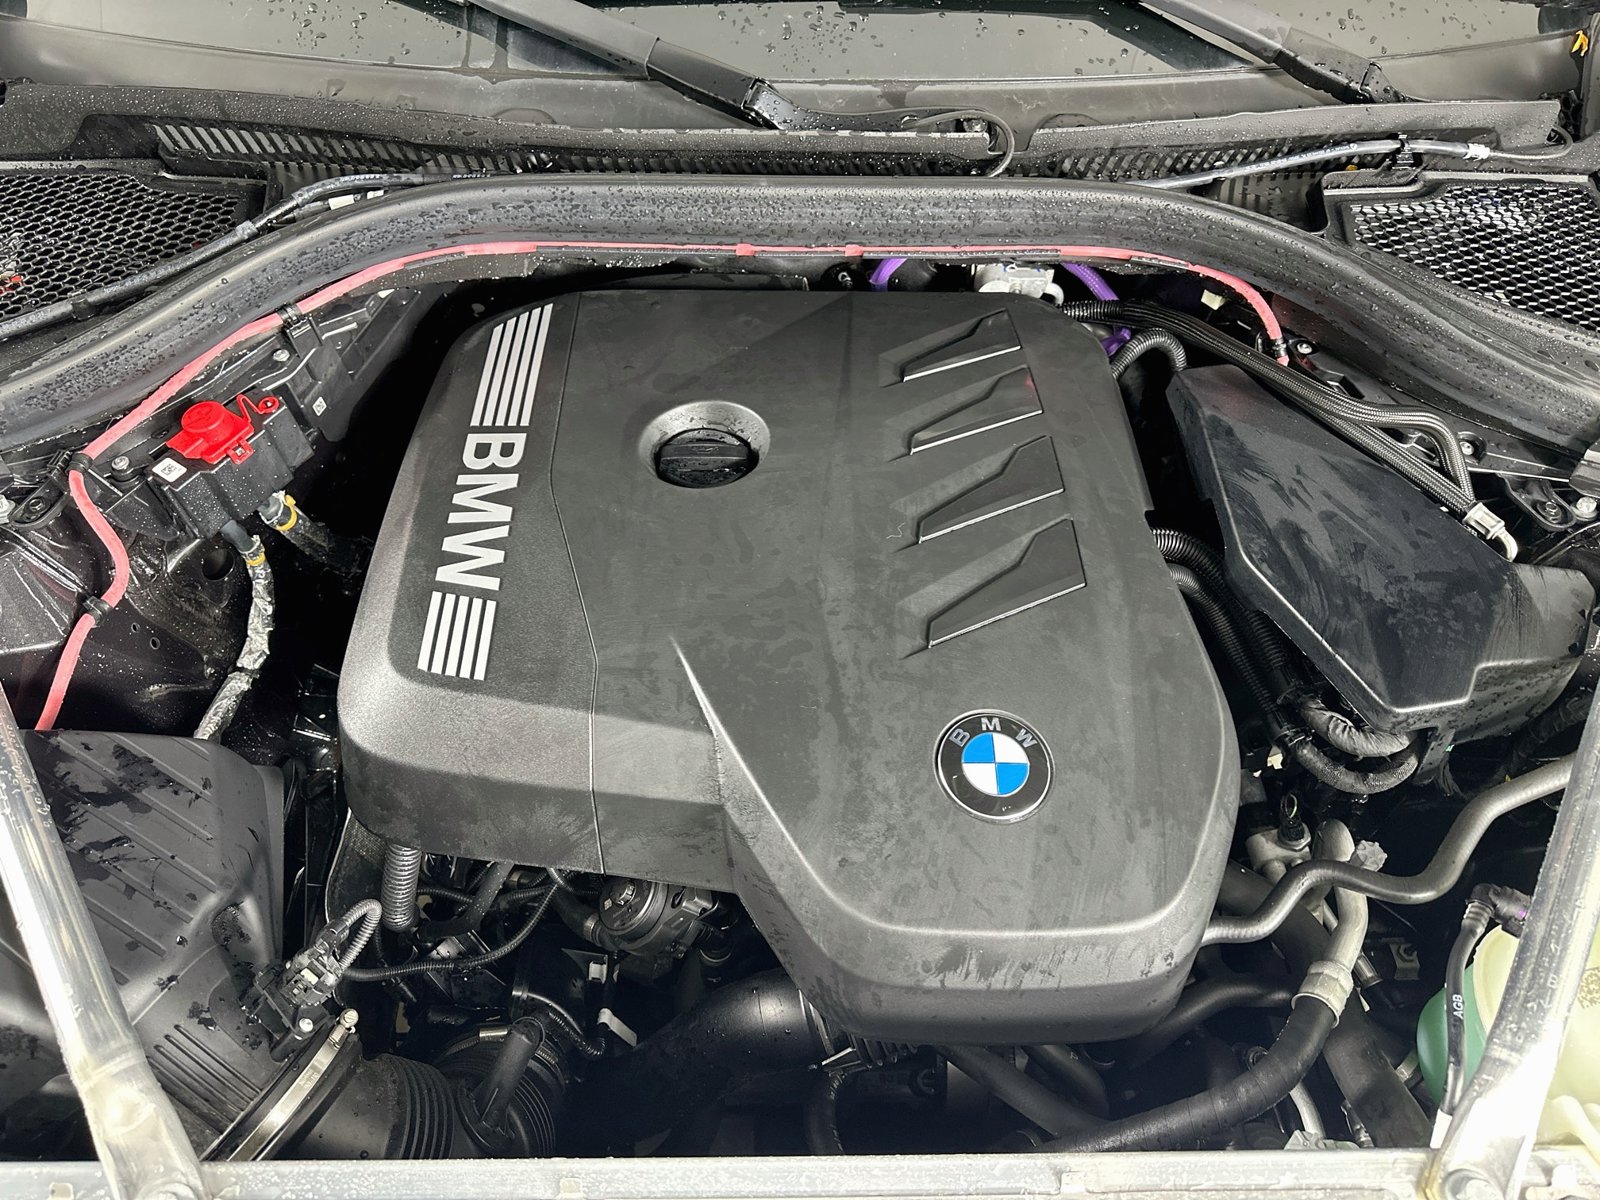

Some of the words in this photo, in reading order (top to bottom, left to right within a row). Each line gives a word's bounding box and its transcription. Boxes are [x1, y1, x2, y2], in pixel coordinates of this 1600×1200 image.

[435, 432, 528, 591] BMW
[948, 716, 1038, 748] BMW
[1452, 993, 1464, 1020] AGB
